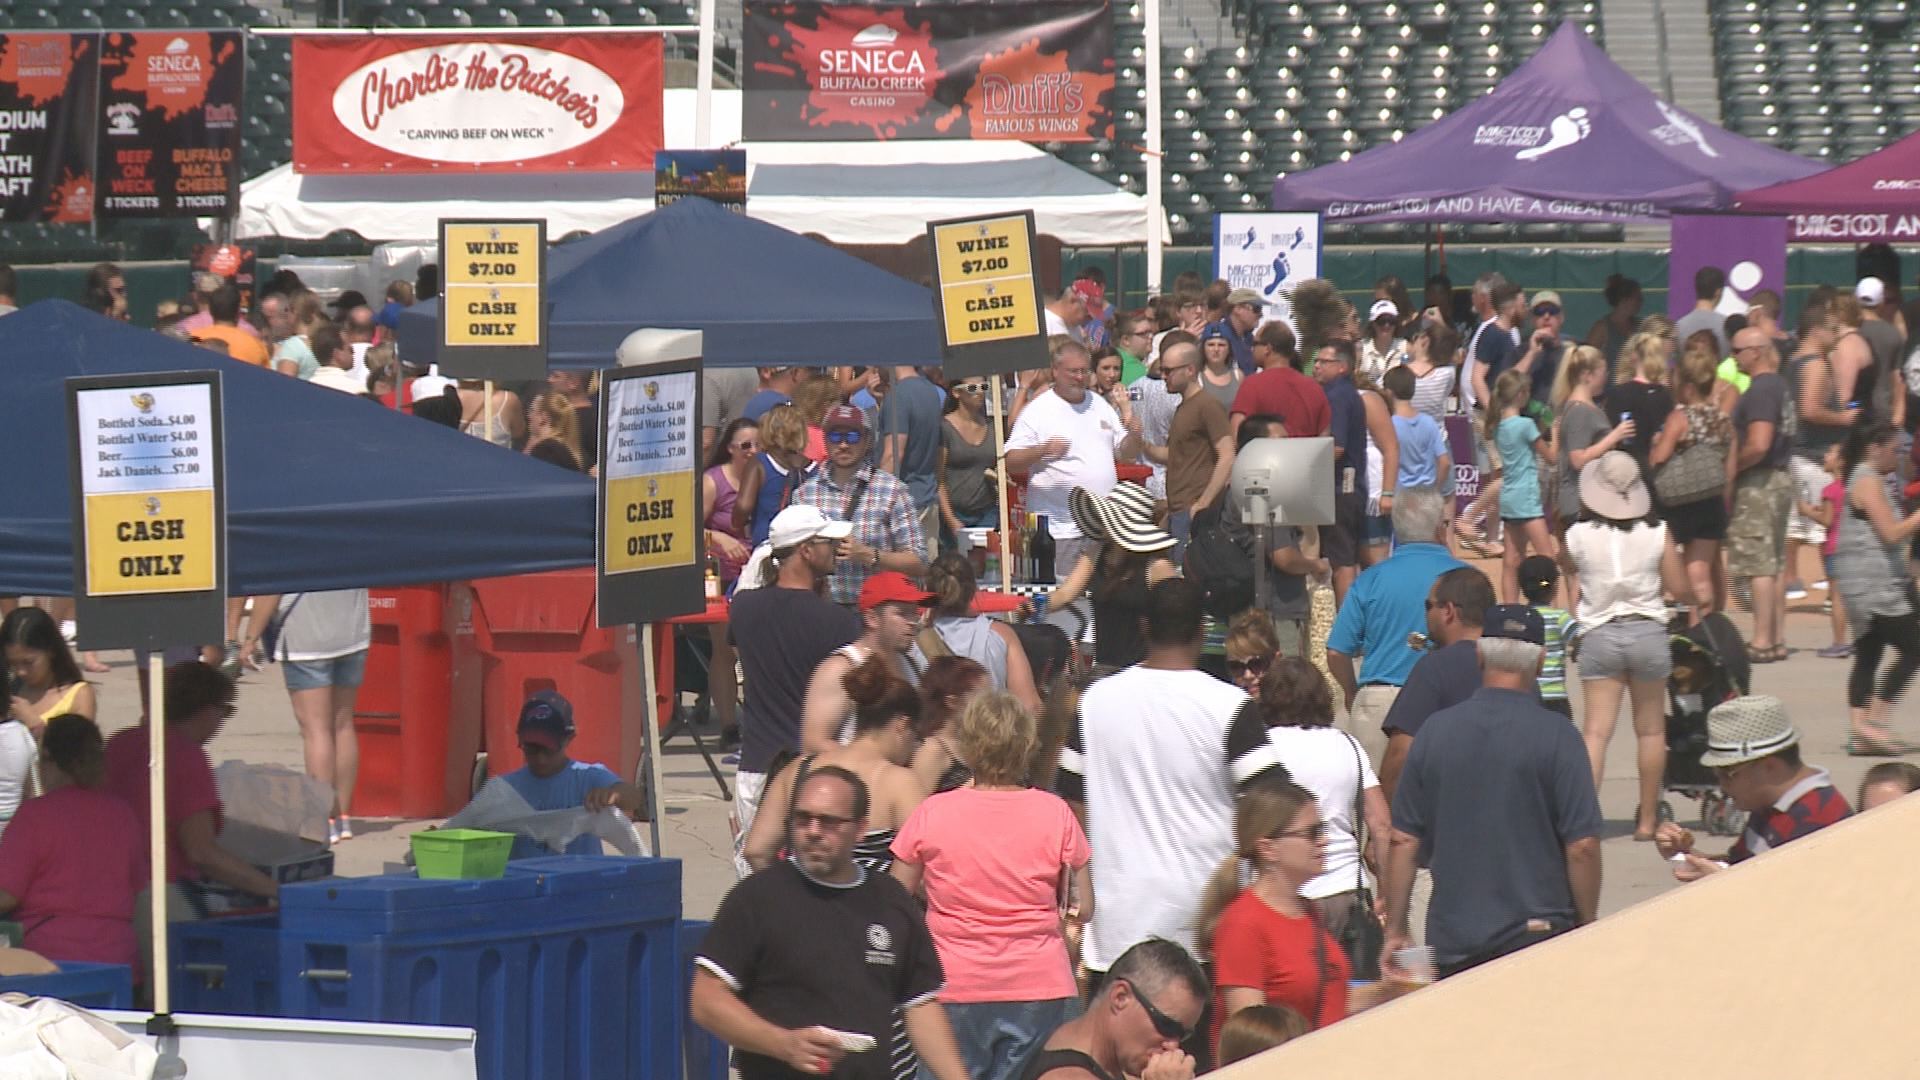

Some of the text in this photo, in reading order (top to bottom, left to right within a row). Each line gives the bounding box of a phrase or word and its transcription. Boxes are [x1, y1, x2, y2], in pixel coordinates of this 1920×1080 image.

[148, 55, 201, 72] SENECA
[819, 49, 926, 74] SENECA
[820, 76, 925, 89] BUFFALO CREEK
[361, 50, 599, 131] Charlie the Butcher's
[983, 71, 1084, 114] Duff's
[850, 97, 896, 107] CASINO
[985, 117, 1079, 133] FAMOUS WINGS
[462, 128, 487, 139] BEEF
[490, 128, 508, 139] ON
[116, 149, 153, 163] BEEF
[172, 148, 233, 163] BUFFALO
[123, 163, 146, 177] ON
[181, 163, 211, 177] MAC
[111, 179, 155, 193] WECK
[175, 177, 228, 192] CHEESE
[114, 196, 160, 208] TICKETS
[184, 195, 226, 207] TICKETS
[1327, 202, 1361, 217] GET
[1434, 197, 1474, 213] AND
[1479, 197, 1525, 213] HAVE
[1528, 200, 1543, 213] A
[466, 242, 518, 254] WINE
[957, 236, 1009, 253] WINE
[469, 262, 516, 277] $7.00
[962, 257, 1009, 274] $7.00
[468, 302, 517, 315] CASH
[966, 295, 1014, 312] CASH
[469, 323, 517, 335] ONLY
[969, 316, 1015, 332] ONLY
[621, 405, 645, 416] Bottled
[98, 417, 135, 428] Bottled
[618, 416, 686, 432] Bottled Water $4.00
[97, 430, 197, 445] Bottled Water $4.00
[617, 453, 633, 463] Jack
[97, 466, 121, 478] Jack
[627, 499, 673, 522] CASH
[117, 519, 184, 542] CASH
[627, 532, 673, 556] ONLY
[119, 554, 184, 577] ONLY
